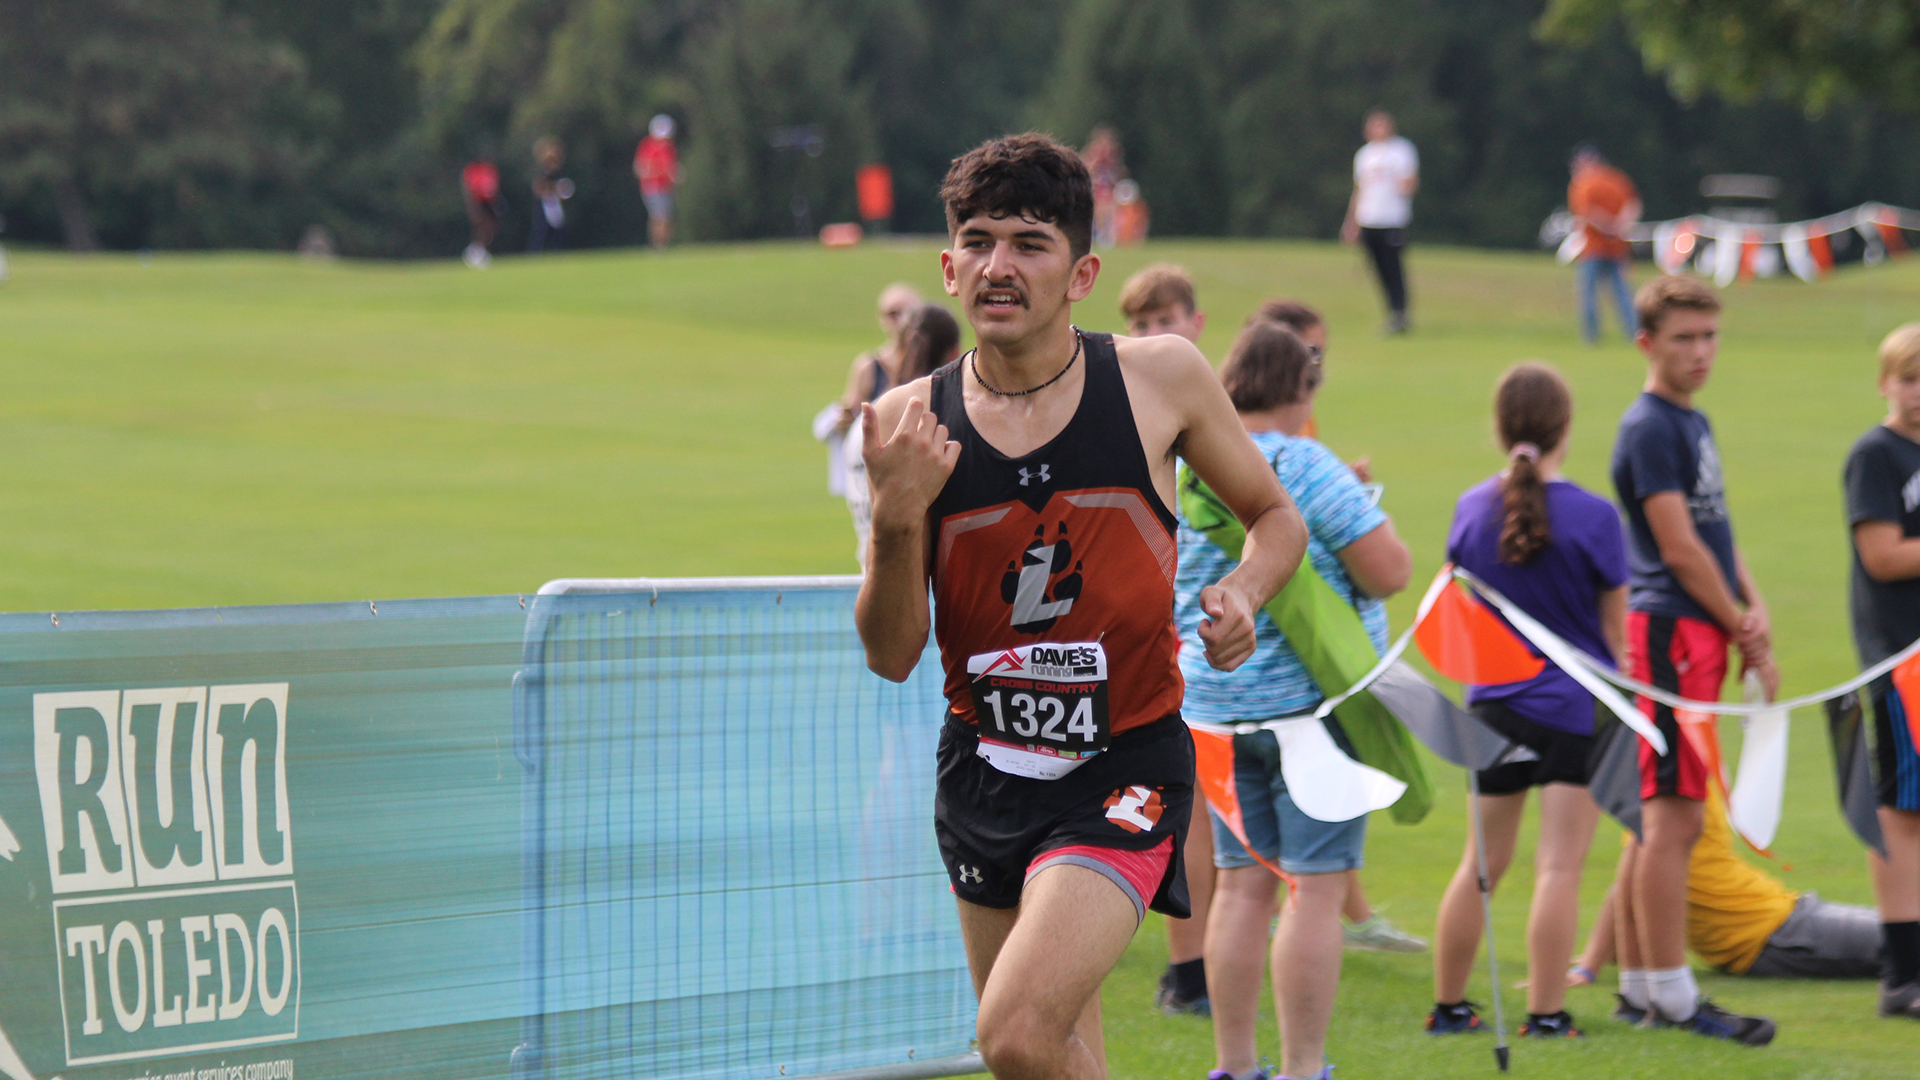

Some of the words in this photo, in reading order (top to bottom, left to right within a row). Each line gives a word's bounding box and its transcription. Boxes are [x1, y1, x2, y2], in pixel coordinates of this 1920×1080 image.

[1031, 646, 1097, 666] DAVE'S
[1031, 665, 1072, 677] running
[990, 677, 1033, 689] CROSS
[1035, 682, 1099, 693] COUNTRY
[983, 690, 1098, 742] 1324
[66, 907, 292, 1035] TOLEDO
[245, 1058, 293, 1080] company
